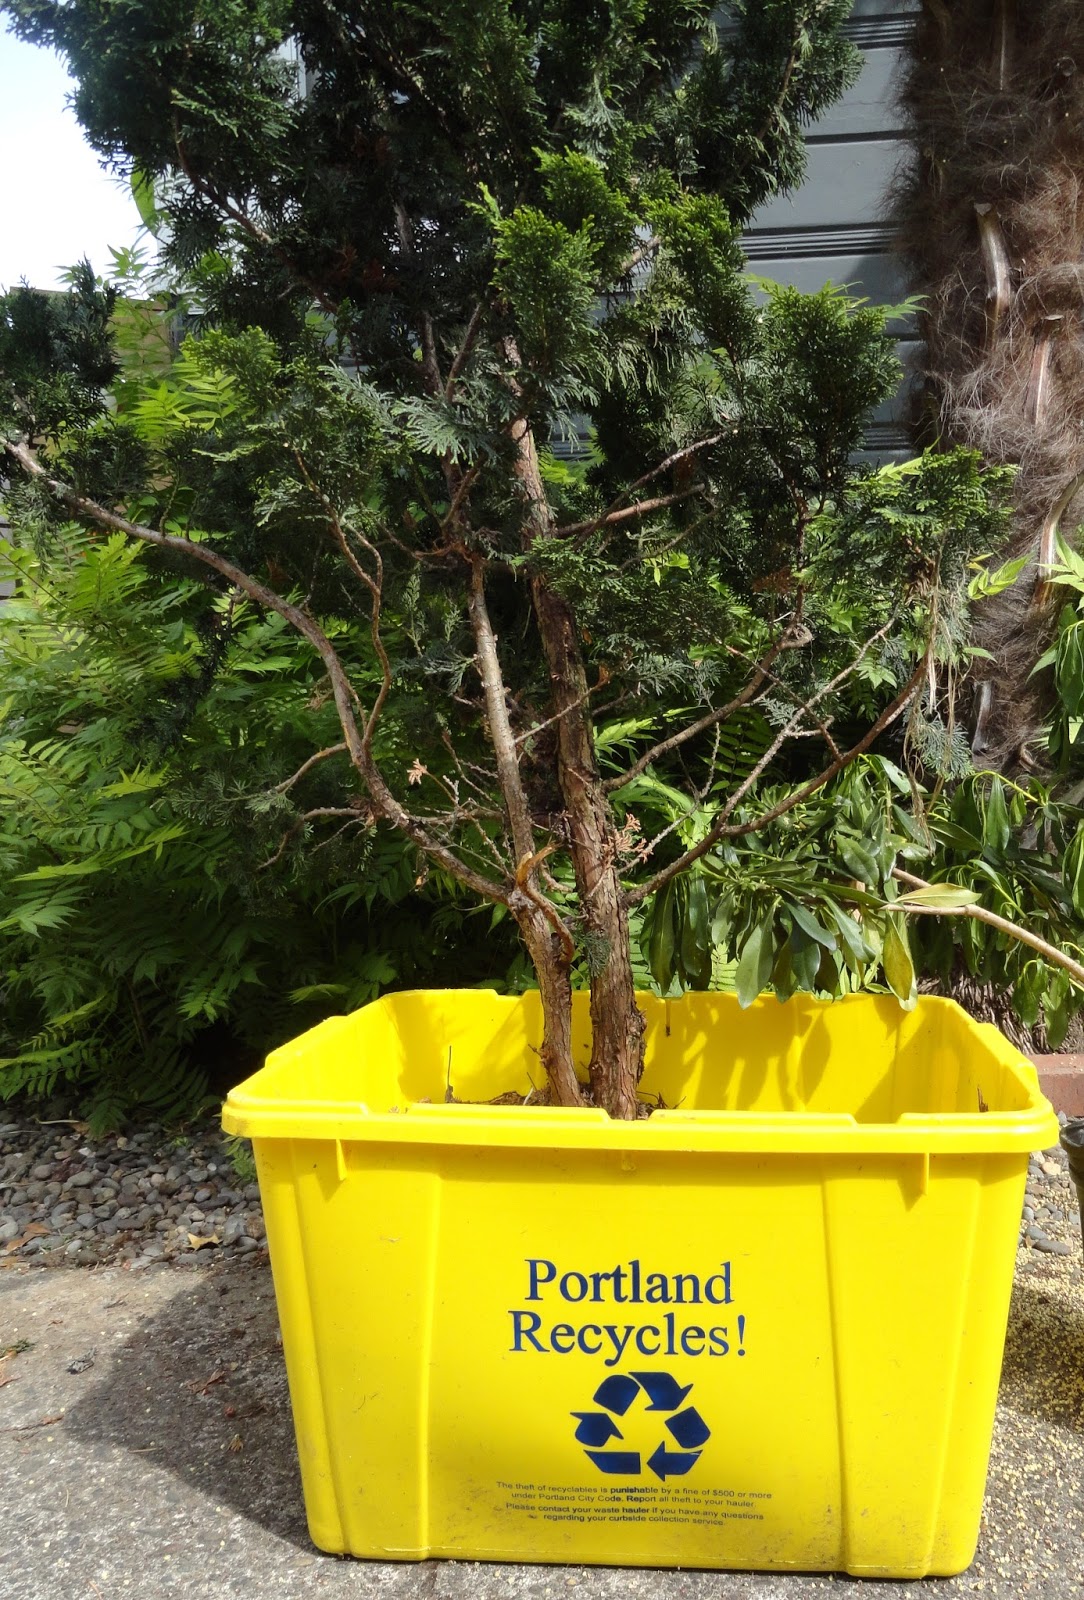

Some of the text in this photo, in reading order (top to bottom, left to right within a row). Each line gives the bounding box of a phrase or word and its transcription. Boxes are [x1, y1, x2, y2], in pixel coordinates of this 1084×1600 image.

[524, 1259, 735, 1305] Portland
[508, 1310, 747, 1367] Recycles!
[496, 1481, 512, 1489] The
[515, 1481, 535, 1491] theft
[548, 1485, 598, 1493] recyclables
[610, 1486, 659, 1495] punishable
[661, 1487, 672, 1495] by
[682, 1487, 699, 1495] fine
[712, 1489, 735, 1498] $500
[539, 1493, 576, 1501] Portland
[578, 1495, 595, 1503] City
[626, 1495, 656, 1503] Report
[505, 1502, 536, 1511] Please
[538, 1505, 570, 1513] contact
[622, 1506, 649, 1514] hauler
[678, 1507, 700, 1516] have
[702, 1510, 719, 1518] any
[721, 1511, 764, 1520] questions
[543, 1514, 585, 1522] regarding
[609, 1514, 646, 1522] curbside
[648, 1515, 690, 1523] collection
